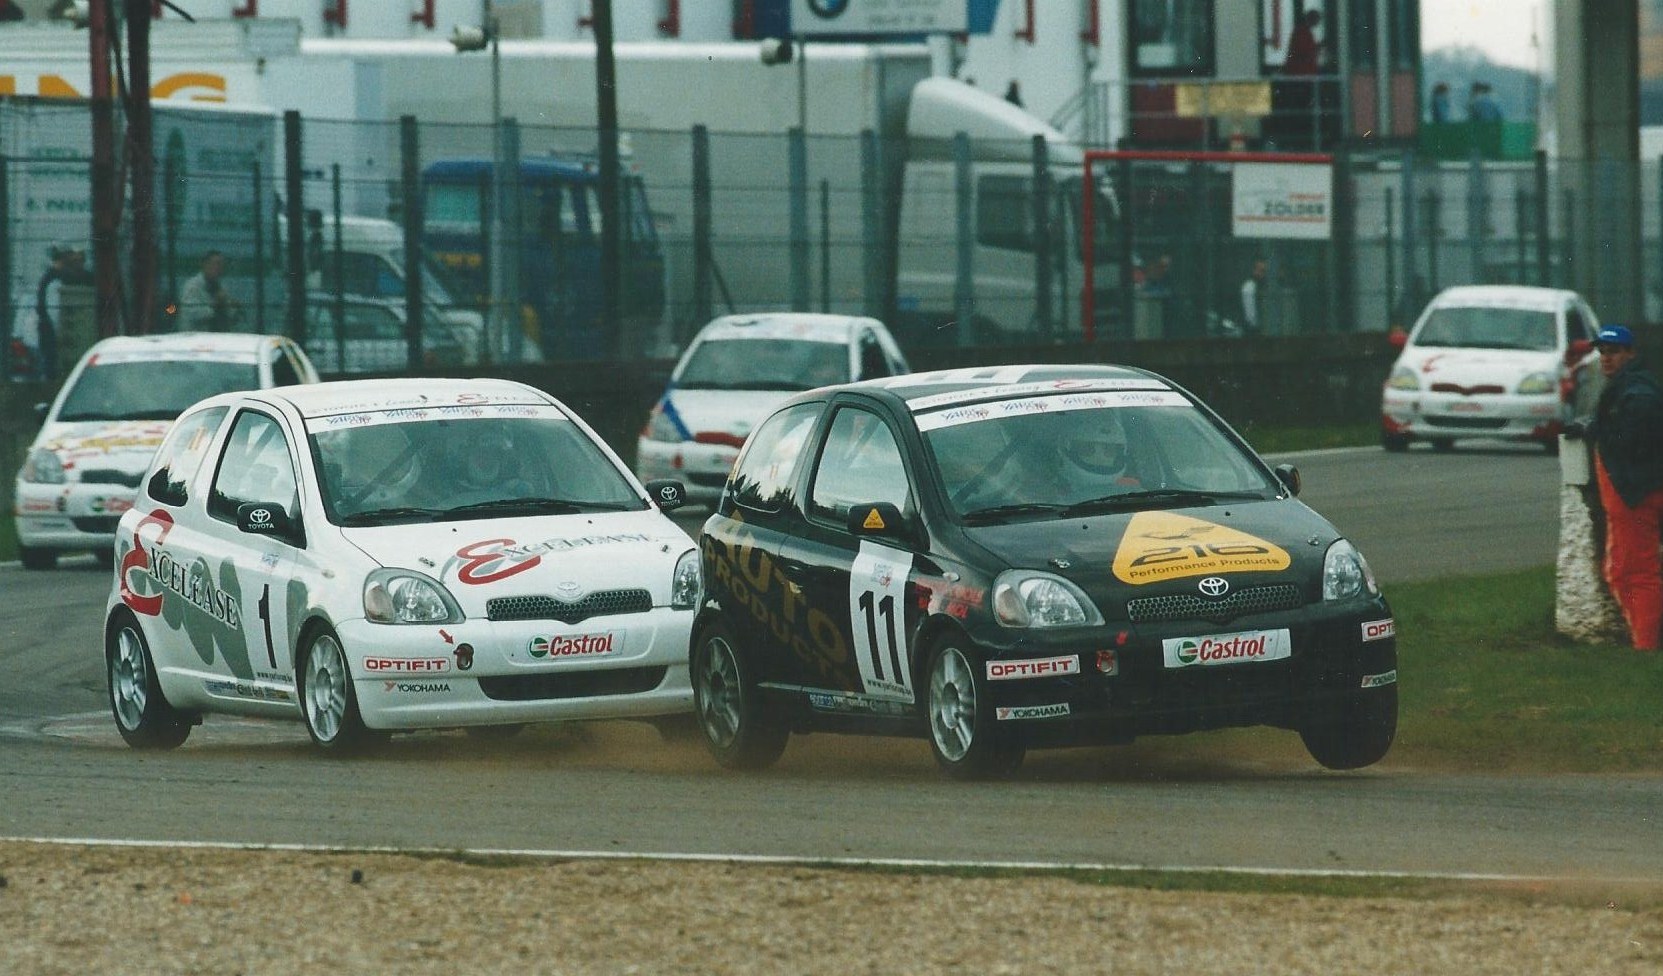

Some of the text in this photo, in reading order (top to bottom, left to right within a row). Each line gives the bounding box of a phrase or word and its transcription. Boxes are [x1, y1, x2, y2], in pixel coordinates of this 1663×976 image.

[1130, 543, 1270, 568] 216
[1130, 558, 1280, 579] Performance Products
[258, 583, 278, 670] 1
[550, 634, 613, 656] Castrol
[858, 590, 905, 686] 11
[1200, 636, 1265, 661] Castrol
[365, 658, 447, 671] OPTIFIT
[991, 660, 1072, 676] OPTIFIT
[397, 682, 451, 693] YOKOHAMA
[1012, 705, 1068, 718] YOKOHAMA
